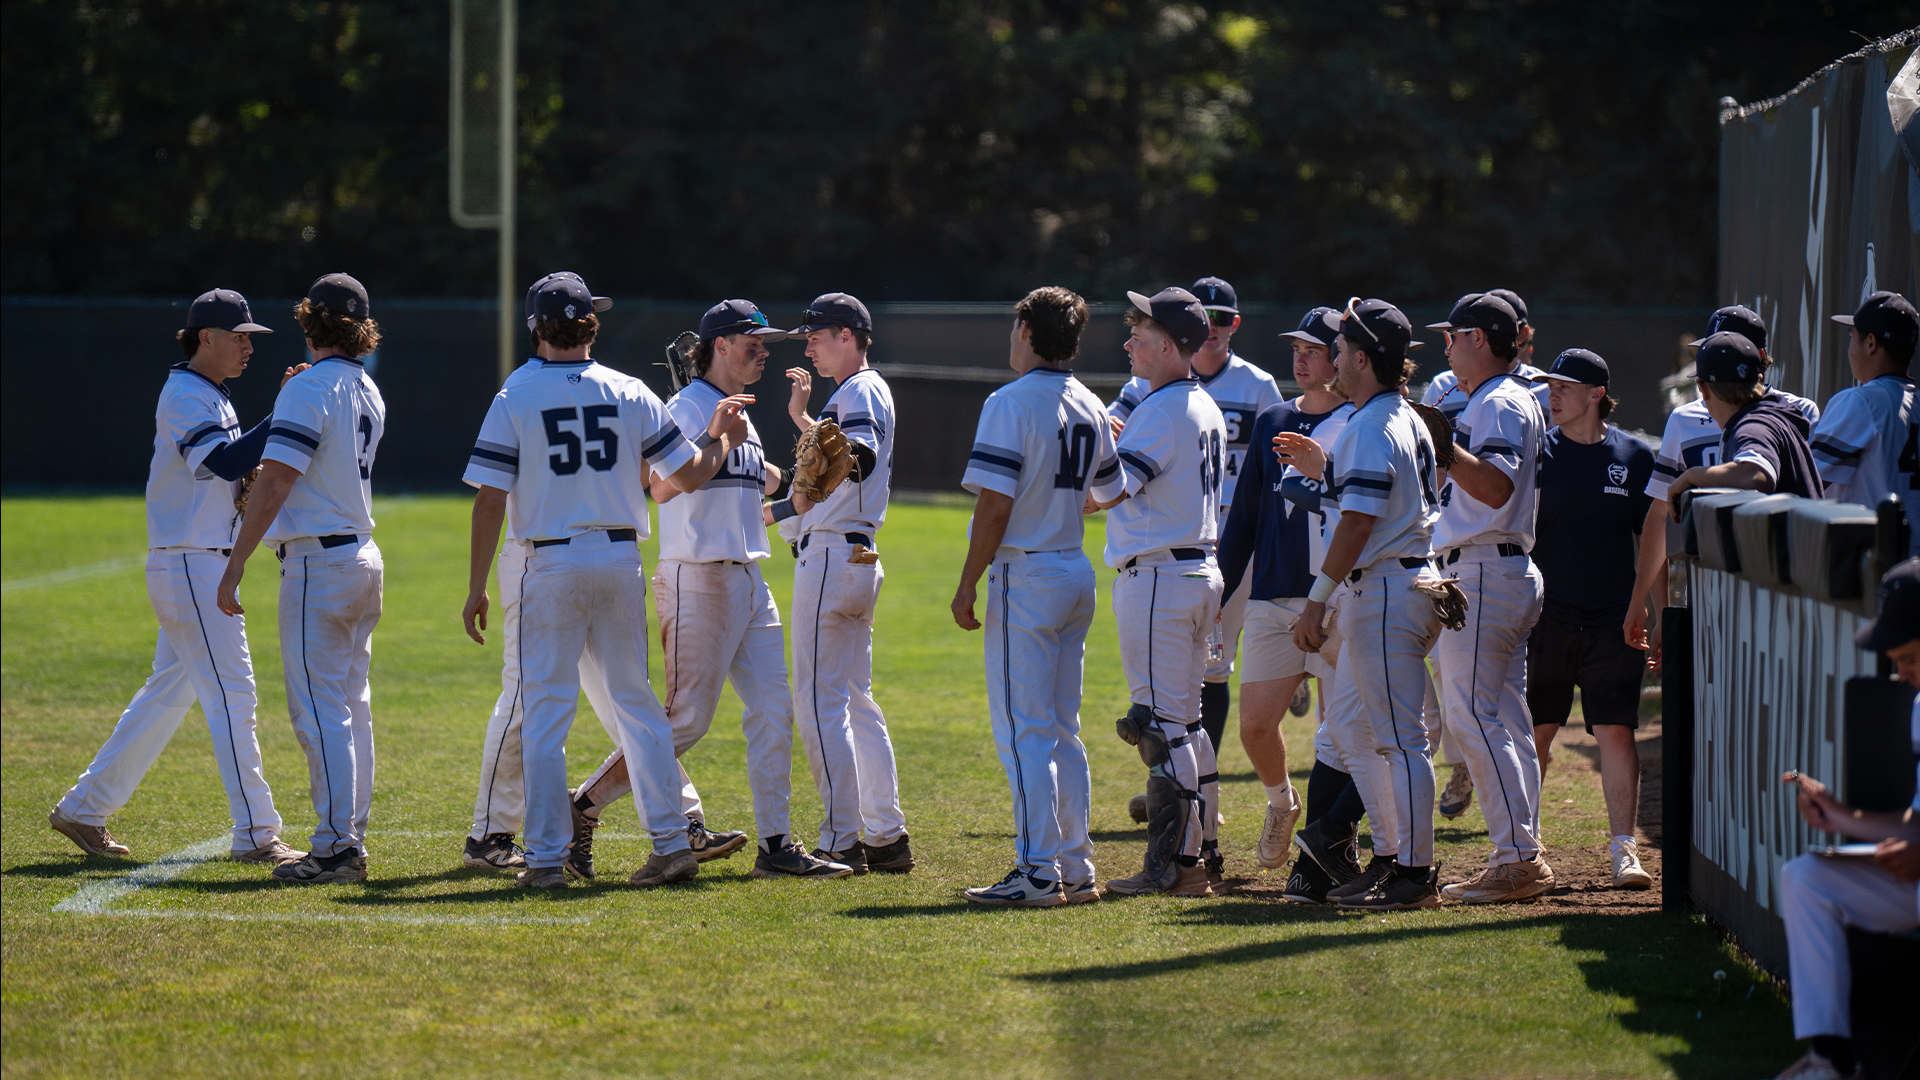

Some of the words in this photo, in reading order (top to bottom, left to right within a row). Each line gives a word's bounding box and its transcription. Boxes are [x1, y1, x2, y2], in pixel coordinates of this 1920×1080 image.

[540, 404, 619, 477] 55
[1053, 421, 1097, 491] 10
[1604, 485, 1629, 497] BASEBALL
